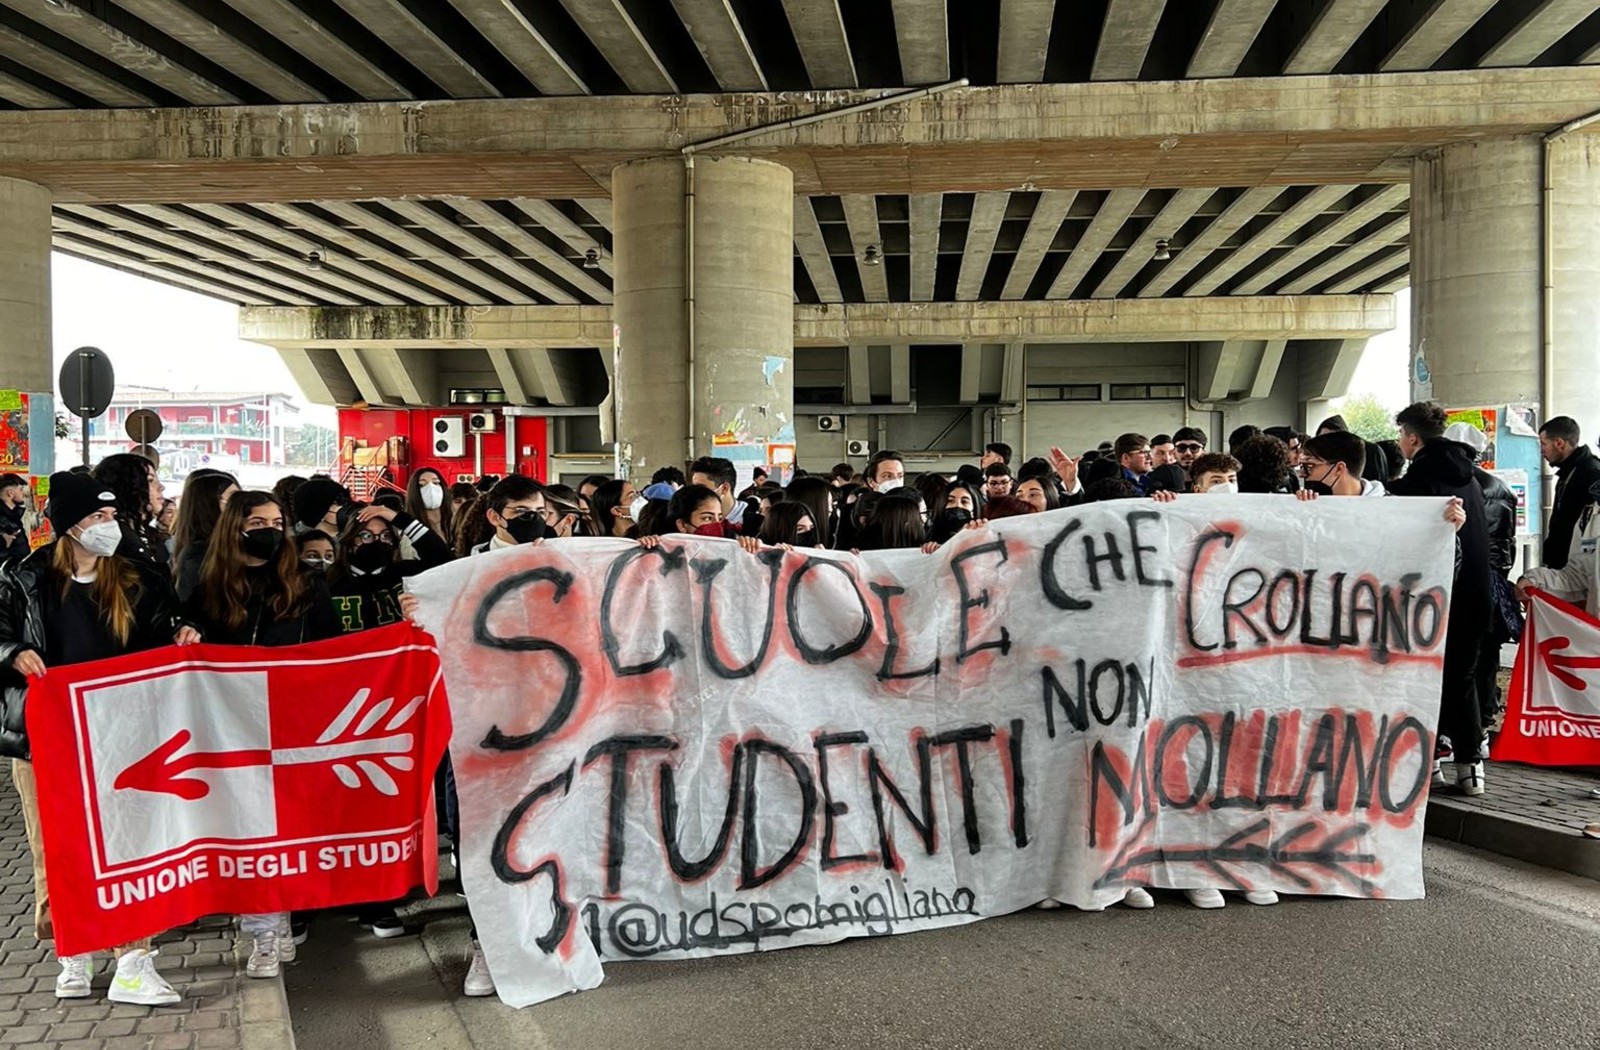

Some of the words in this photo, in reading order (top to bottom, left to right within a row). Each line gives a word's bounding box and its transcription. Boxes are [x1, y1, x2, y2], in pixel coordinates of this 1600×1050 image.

[473, 532, 1012, 750] SCUOLE
[1040, 510, 1173, 609] CHE
[1183, 531, 1446, 662] CROLLANO
[1042, 657, 1154, 738] NON
[1520, 719, 1600, 739] UNIONE
[1089, 710, 1430, 848] MOLLANO
[490, 718, 1028, 953] STUDENTI
[97, 855, 209, 910] UNIONE
[218, 850, 308, 879] DEGLI
[608, 879, 979, 957] @udspomigliano
